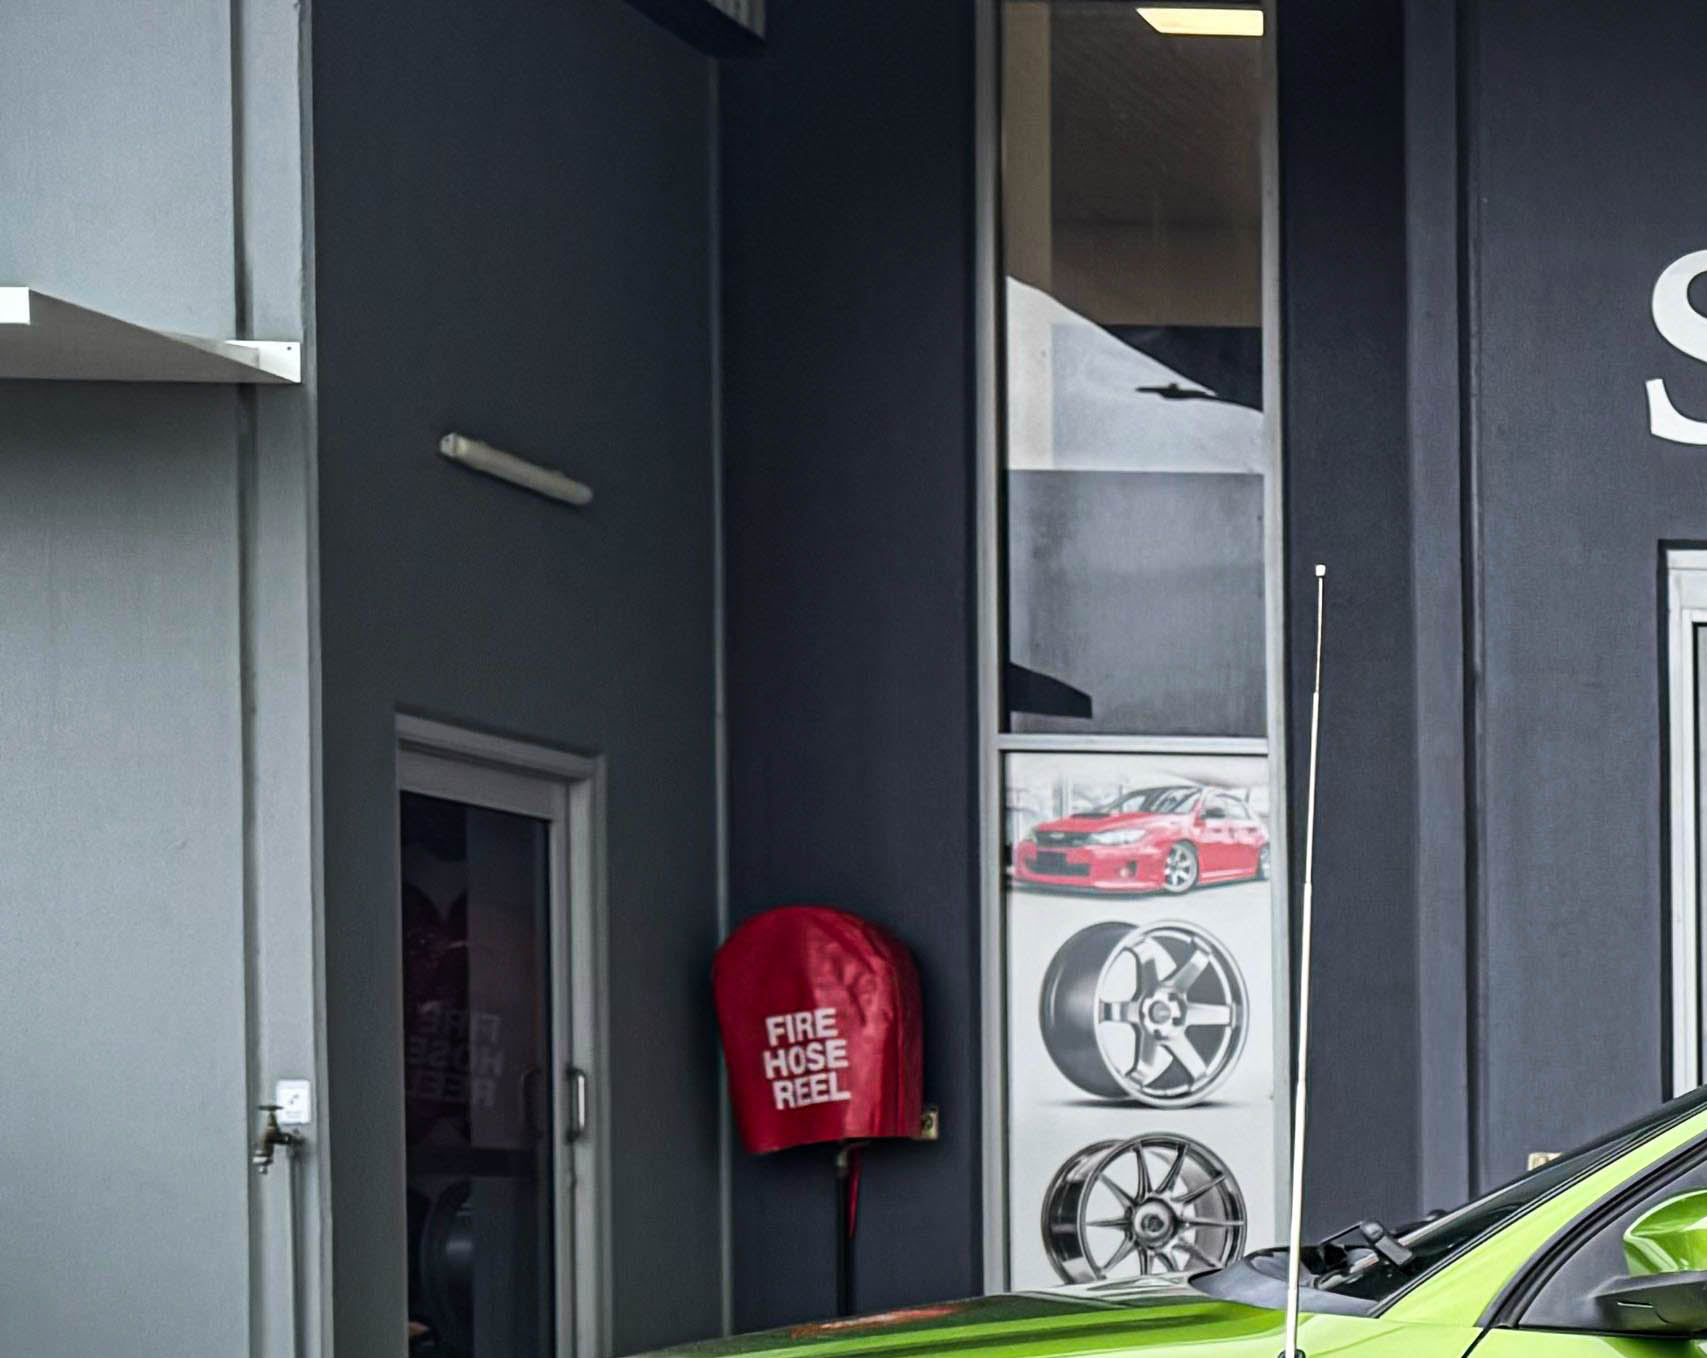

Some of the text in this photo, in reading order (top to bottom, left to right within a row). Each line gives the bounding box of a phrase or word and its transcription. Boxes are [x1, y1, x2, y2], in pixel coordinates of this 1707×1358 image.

[764, 1007, 839, 1047] FIRE
[762, 1038, 850, 1080] HOSE
[772, 1071, 852, 1110] REEL
